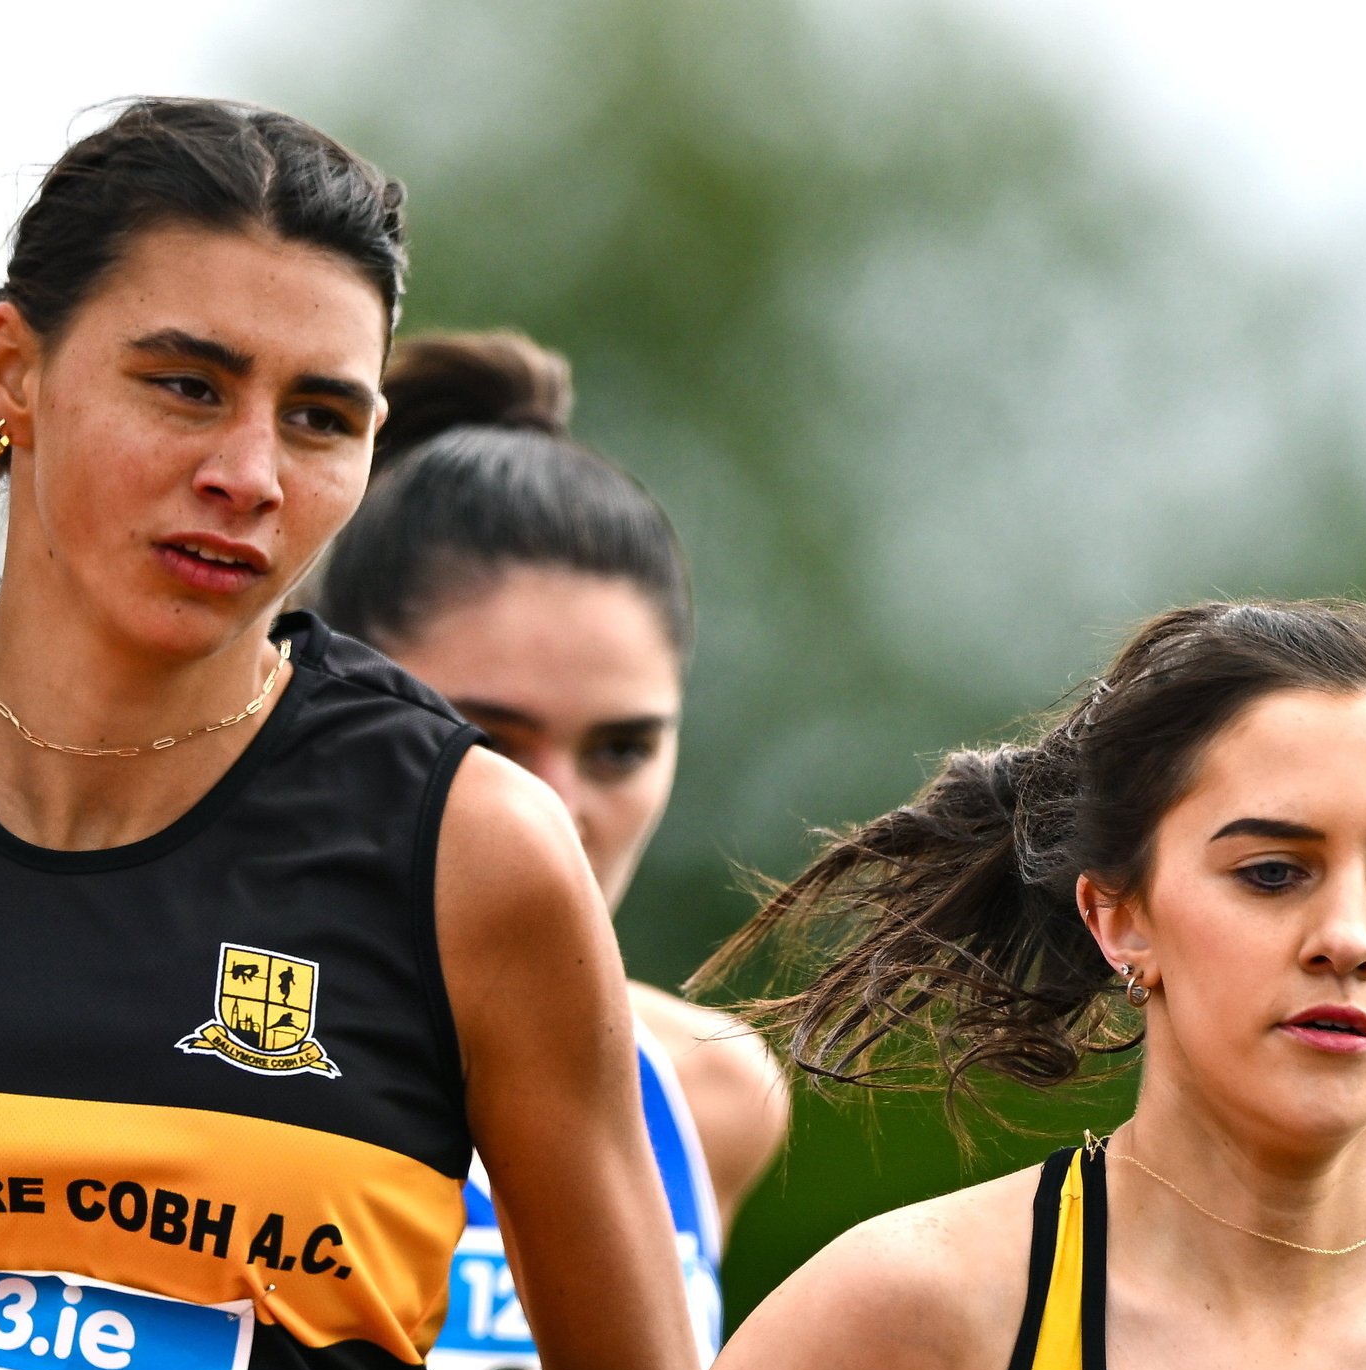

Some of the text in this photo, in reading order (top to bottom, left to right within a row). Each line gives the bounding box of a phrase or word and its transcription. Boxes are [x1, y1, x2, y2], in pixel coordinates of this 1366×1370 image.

[211, 1035, 316, 1068] BALLYMORE COBH A.C.
[65, 1177, 236, 1259] COBH
[247, 1212, 353, 1280] A.C.
